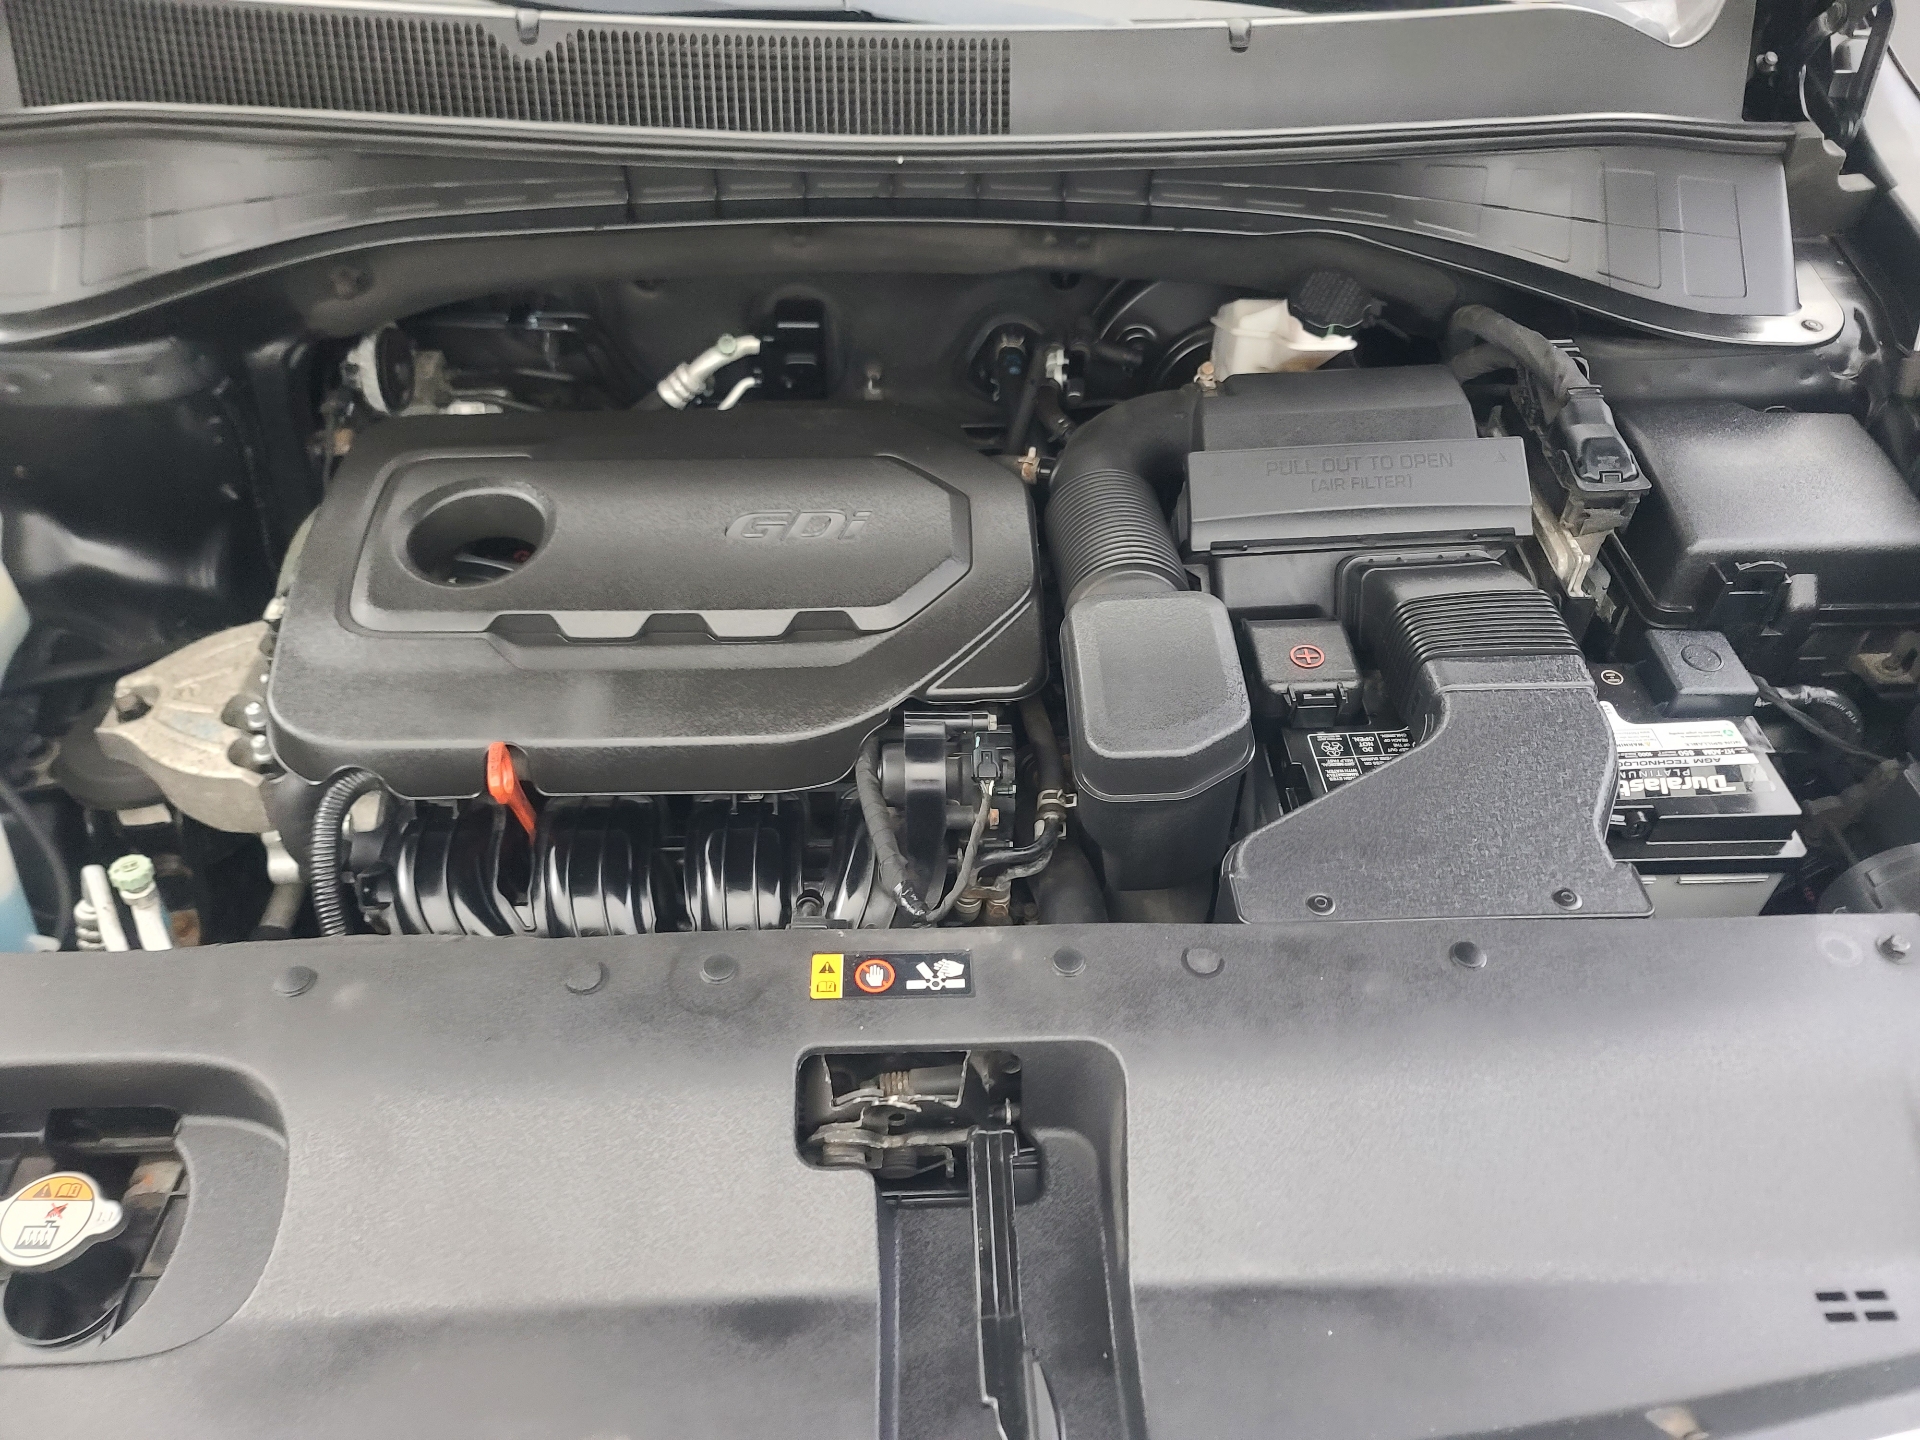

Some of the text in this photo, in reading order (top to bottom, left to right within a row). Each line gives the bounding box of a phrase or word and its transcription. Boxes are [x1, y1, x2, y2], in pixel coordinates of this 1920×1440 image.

[1265, 452, 1453, 476] PULL OUT TO OPEN
[725, 510, 873, 541] GDi
[1619, 774, 1736, 797] Duralast
